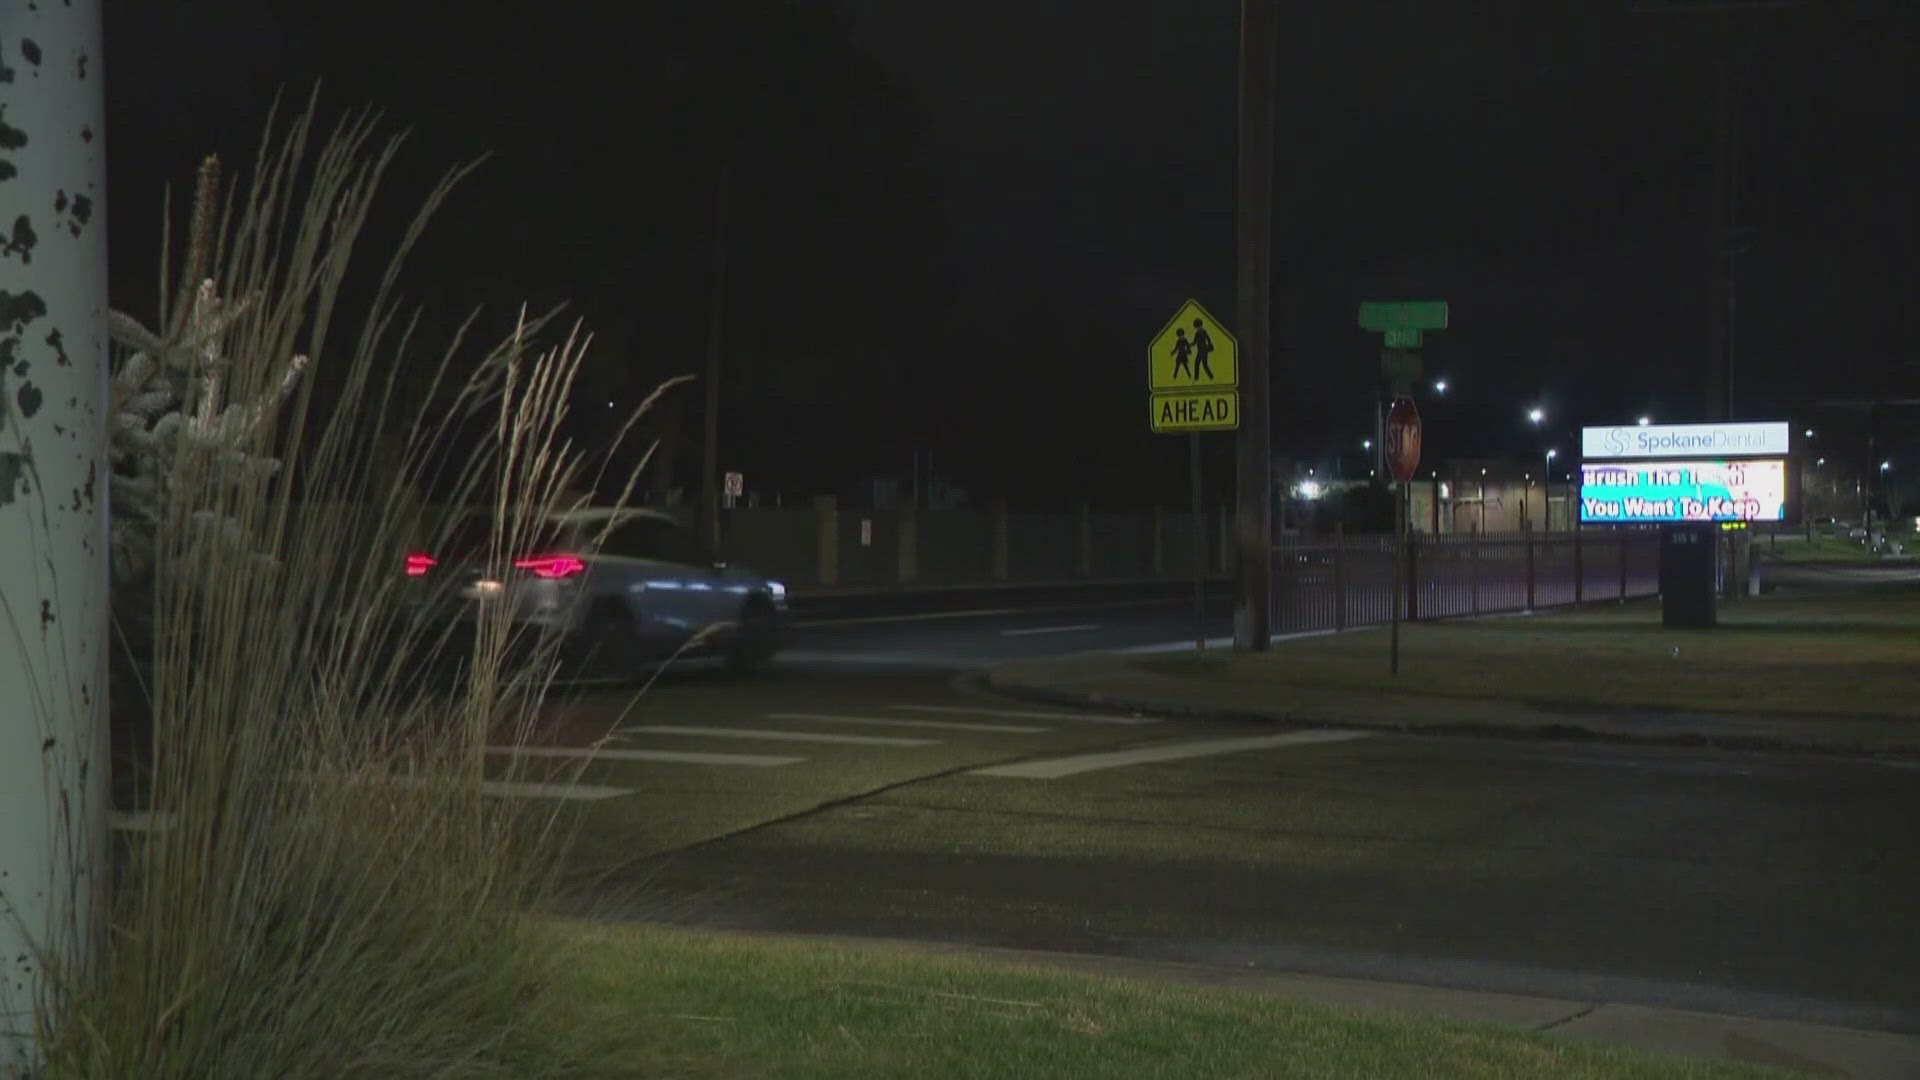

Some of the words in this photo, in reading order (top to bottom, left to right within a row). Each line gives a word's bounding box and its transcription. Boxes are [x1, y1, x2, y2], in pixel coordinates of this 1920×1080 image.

[1161, 398, 1228, 423] AHEAD
[1388, 423, 1418, 454] STOP
[1583, 497, 1620, 517] You
[1622, 496, 1675, 517] Want
[1679, 495, 1703, 516] To
[1707, 495, 1760, 520] Keep
